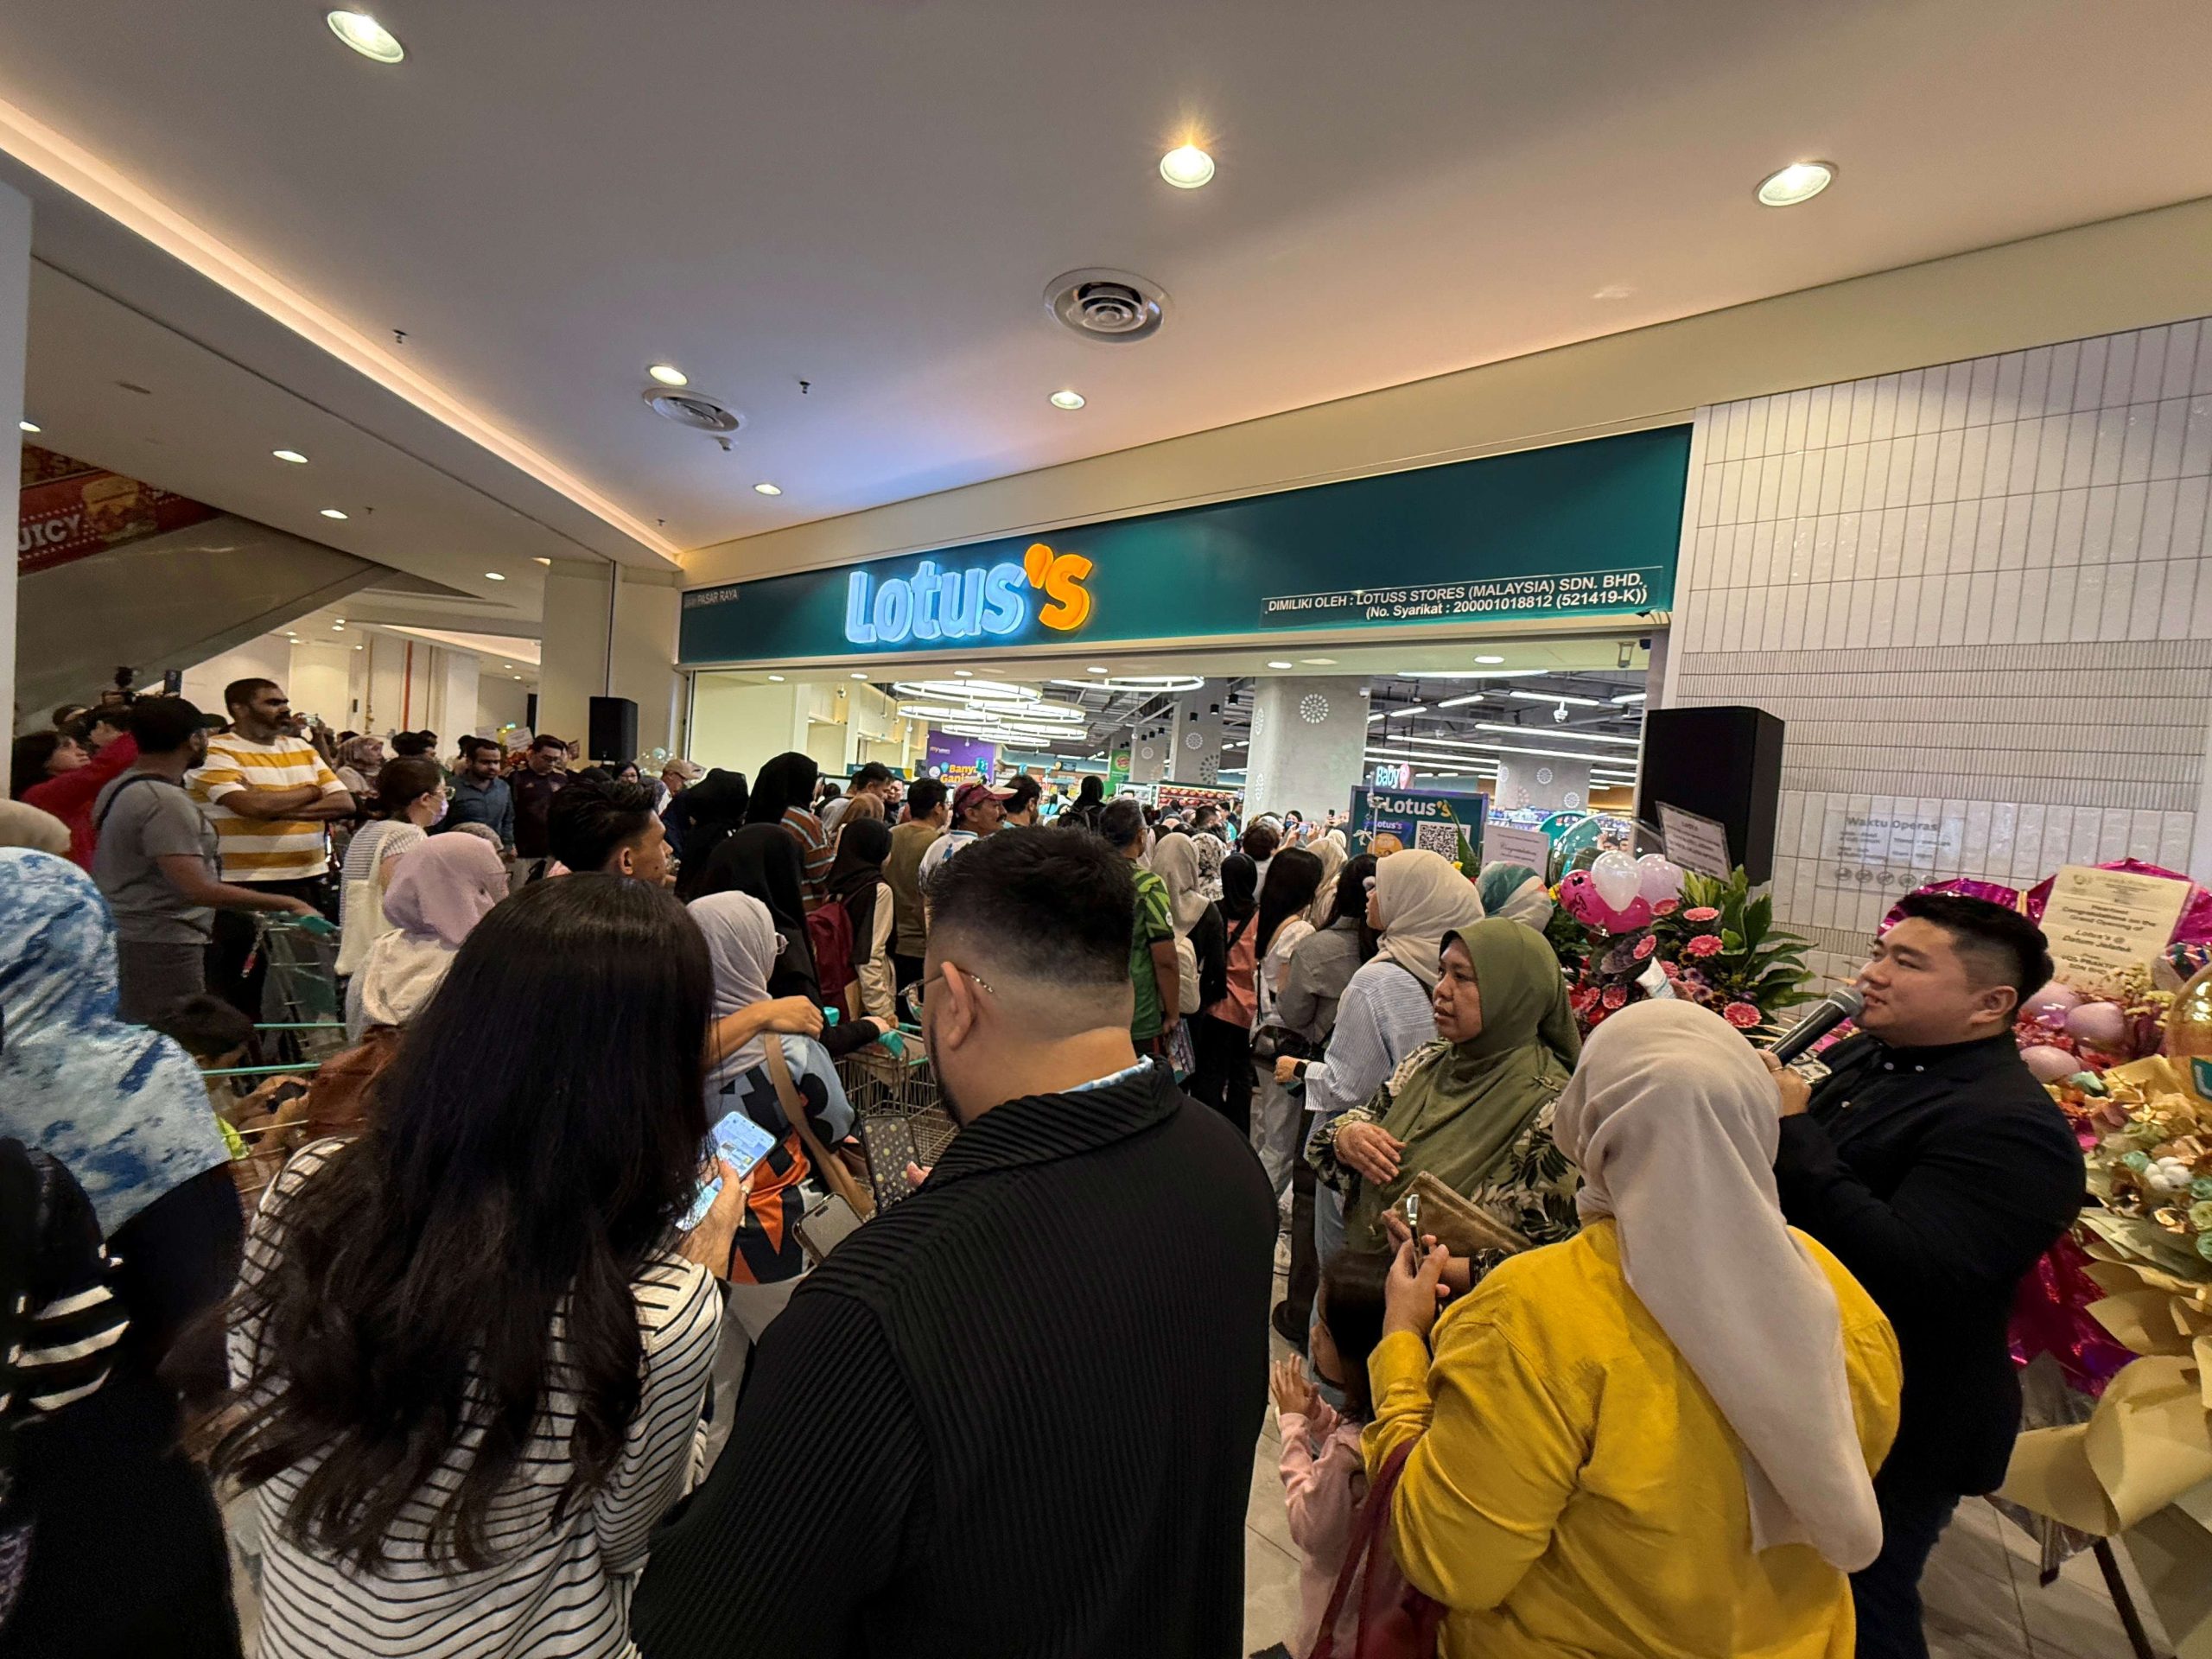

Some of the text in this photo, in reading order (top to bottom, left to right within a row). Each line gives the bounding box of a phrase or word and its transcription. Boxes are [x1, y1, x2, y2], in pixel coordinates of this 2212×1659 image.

[697, 591, 719, 604] PASAR
[720, 588, 738, 601] RAYA
[845, 543, 1093, 644] Lotus's
[1268, 598, 1312, 612] DIMILIKI
[1314, 595, 1346, 607] OLEH
[1356, 592, 1407, 606] LOTUSS
[1409, 587, 1465, 602] STORES
[1469, 580, 1554, 600] (MALAYSIA)
[1559, 577, 1597, 591] SDN.
[1603, 573, 1643, 588] BHD.
[1366, 607, 1389, 620] (No.
[1393, 603, 1442, 619] Syarikat
[1453, 594, 1553, 613] 200001018812
[1375, 765, 1400, 789] Baby
[1385, 797, 1452, 817] Lotus's
[1847, 817, 1888, 827] Waktu
[2062, 906, 2126, 922] Congratulations
[2069, 914, 2094, 924] Grand
[2096, 918, 2132, 931] Opening
[2063, 935, 2094, 945] Datum
[2075, 929, 2111, 941] Lotus's
